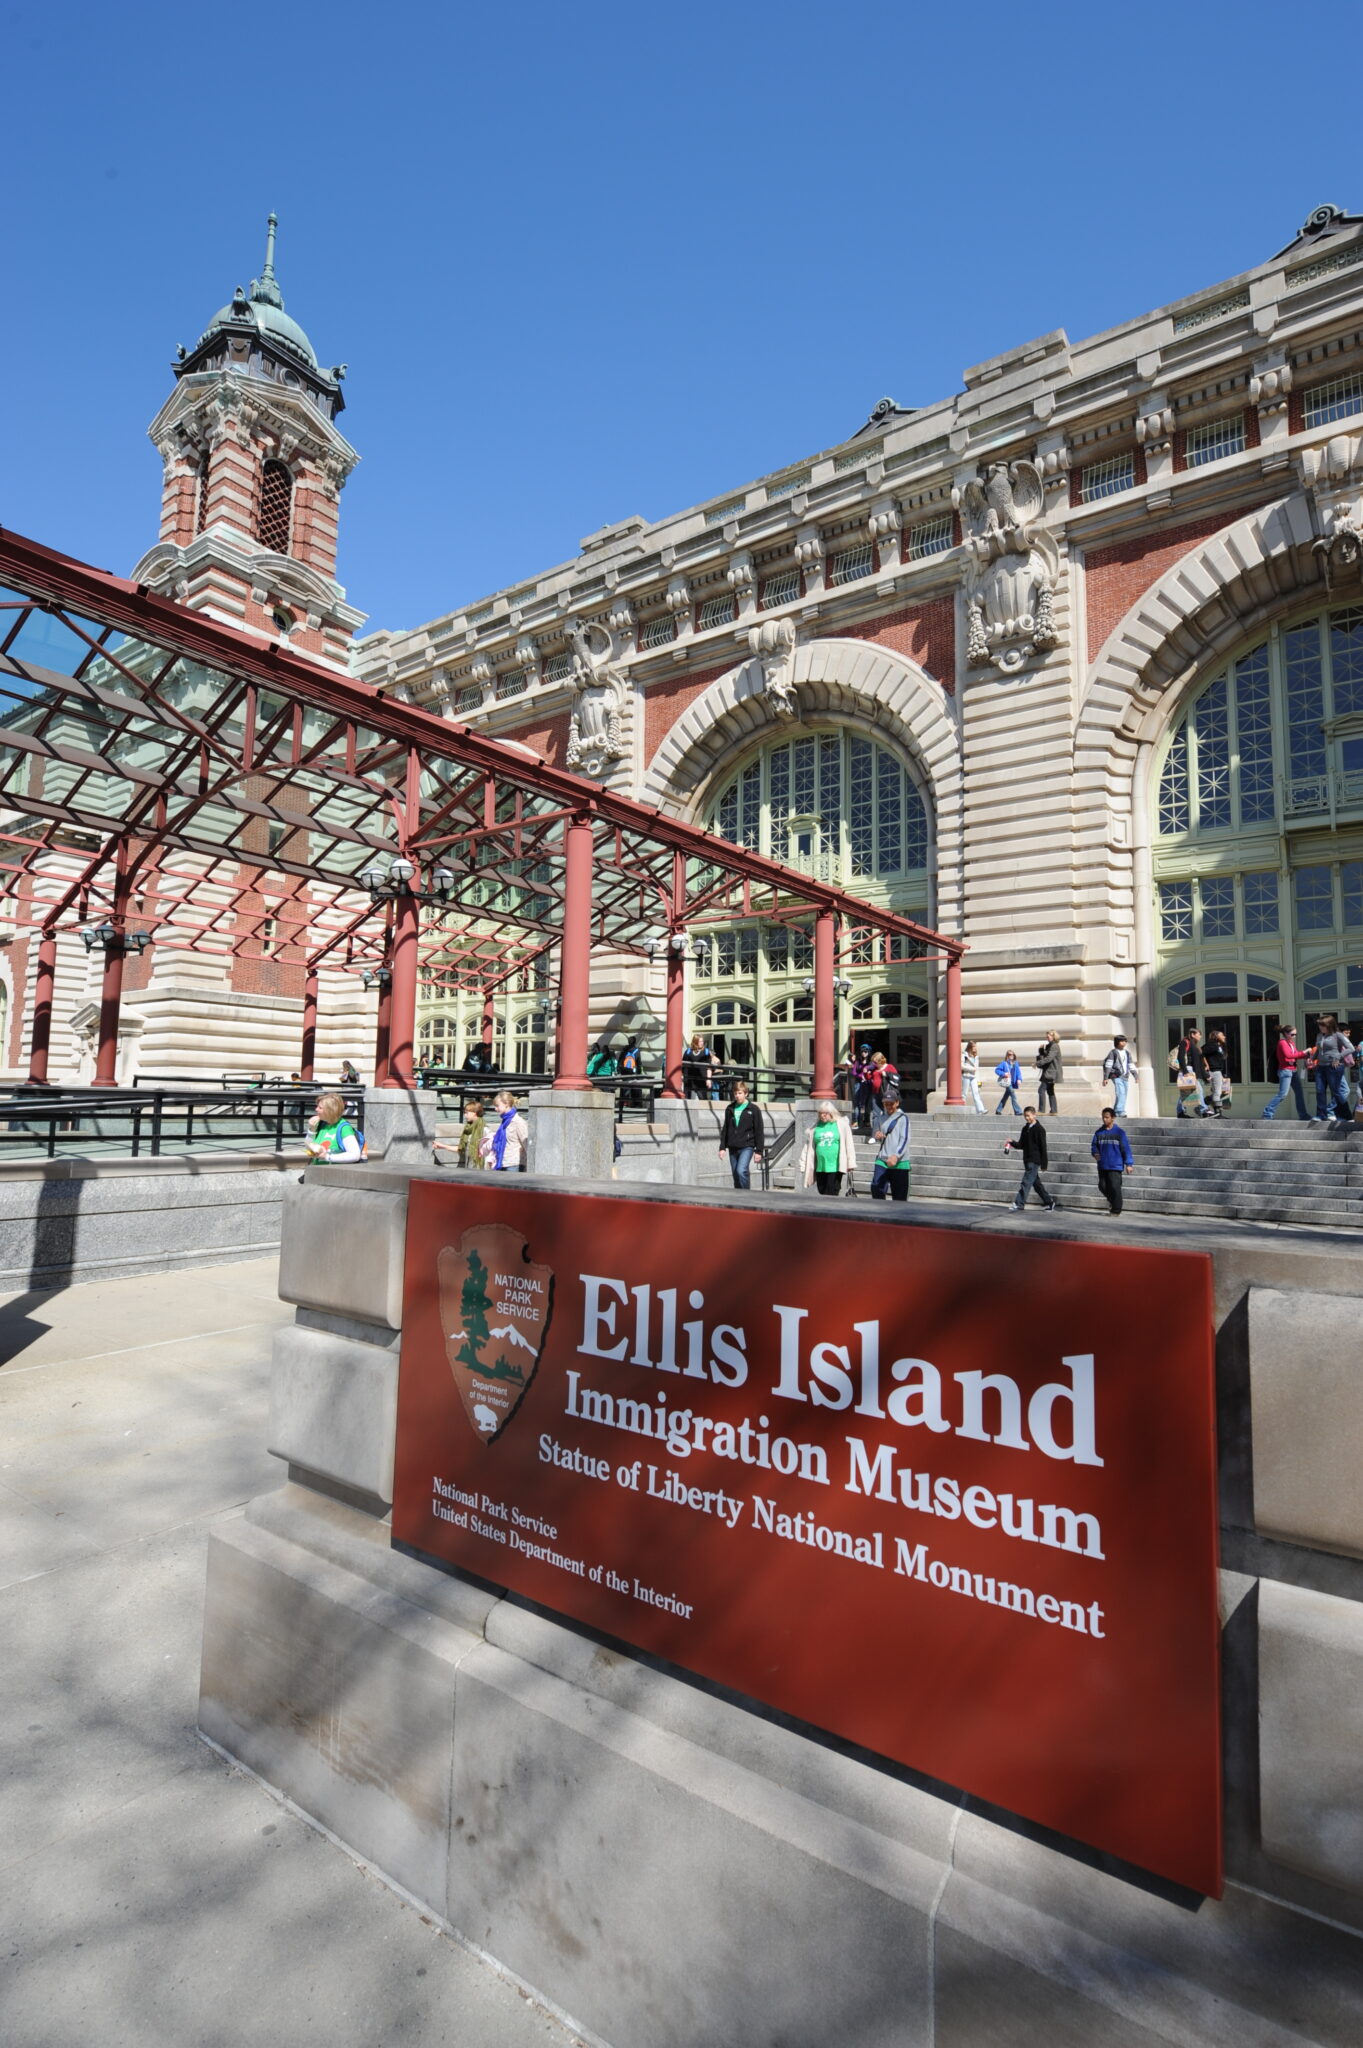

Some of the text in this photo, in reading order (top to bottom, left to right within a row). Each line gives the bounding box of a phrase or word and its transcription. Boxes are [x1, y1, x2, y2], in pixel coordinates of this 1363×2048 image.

[494, 1273, 544, 1294] NATIONAL
[505, 1291, 532, 1306] PARK
[496, 1301, 540, 1321] SERVICE
[472, 1379, 508, 1396] Department
[576, 1273, 1105, 1468] Ellis Island
[469, 1390, 510, 1409] of the Interior
[564, 1369, 1106, 1561] Immigration Museum
[432, 1476, 558, 1540] National Park Service
[538, 1433, 1106, 1639] Statue of Liberty National Monument
[432, 1498, 694, 1620] United States Department of the Interior
